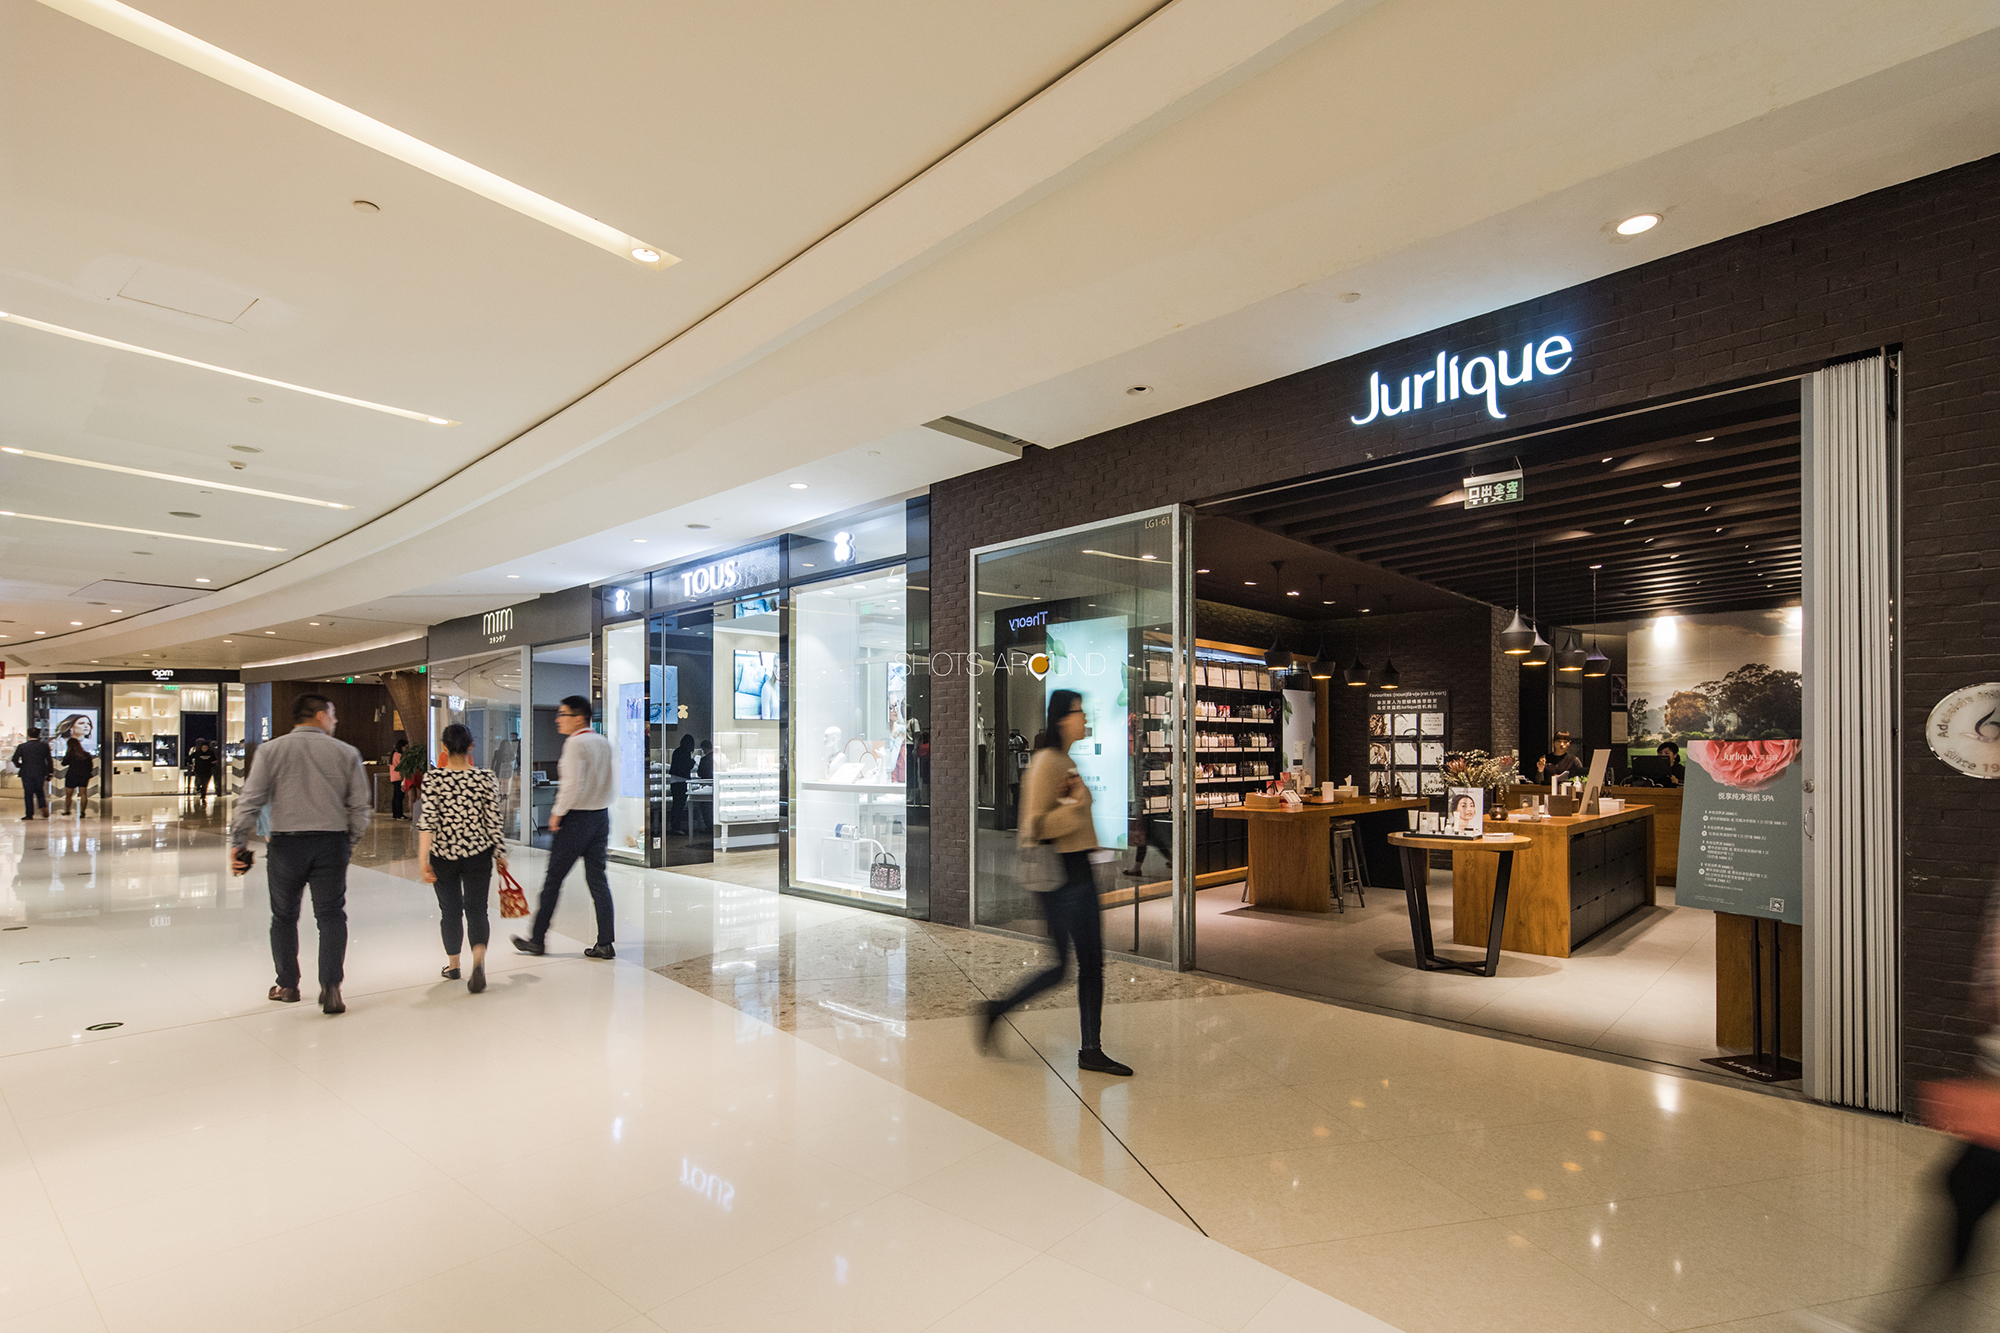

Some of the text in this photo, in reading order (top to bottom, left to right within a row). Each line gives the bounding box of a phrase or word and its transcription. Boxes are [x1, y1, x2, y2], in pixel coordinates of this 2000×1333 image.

[1350, 335, 1573, 425] Jurlique
[1144, 516, 1170, 529] LG1-61
[681, 560, 738, 597] TOUS
[151, 669, 174, 678] apm
[1721, 752, 1756, 766] Jurlique
